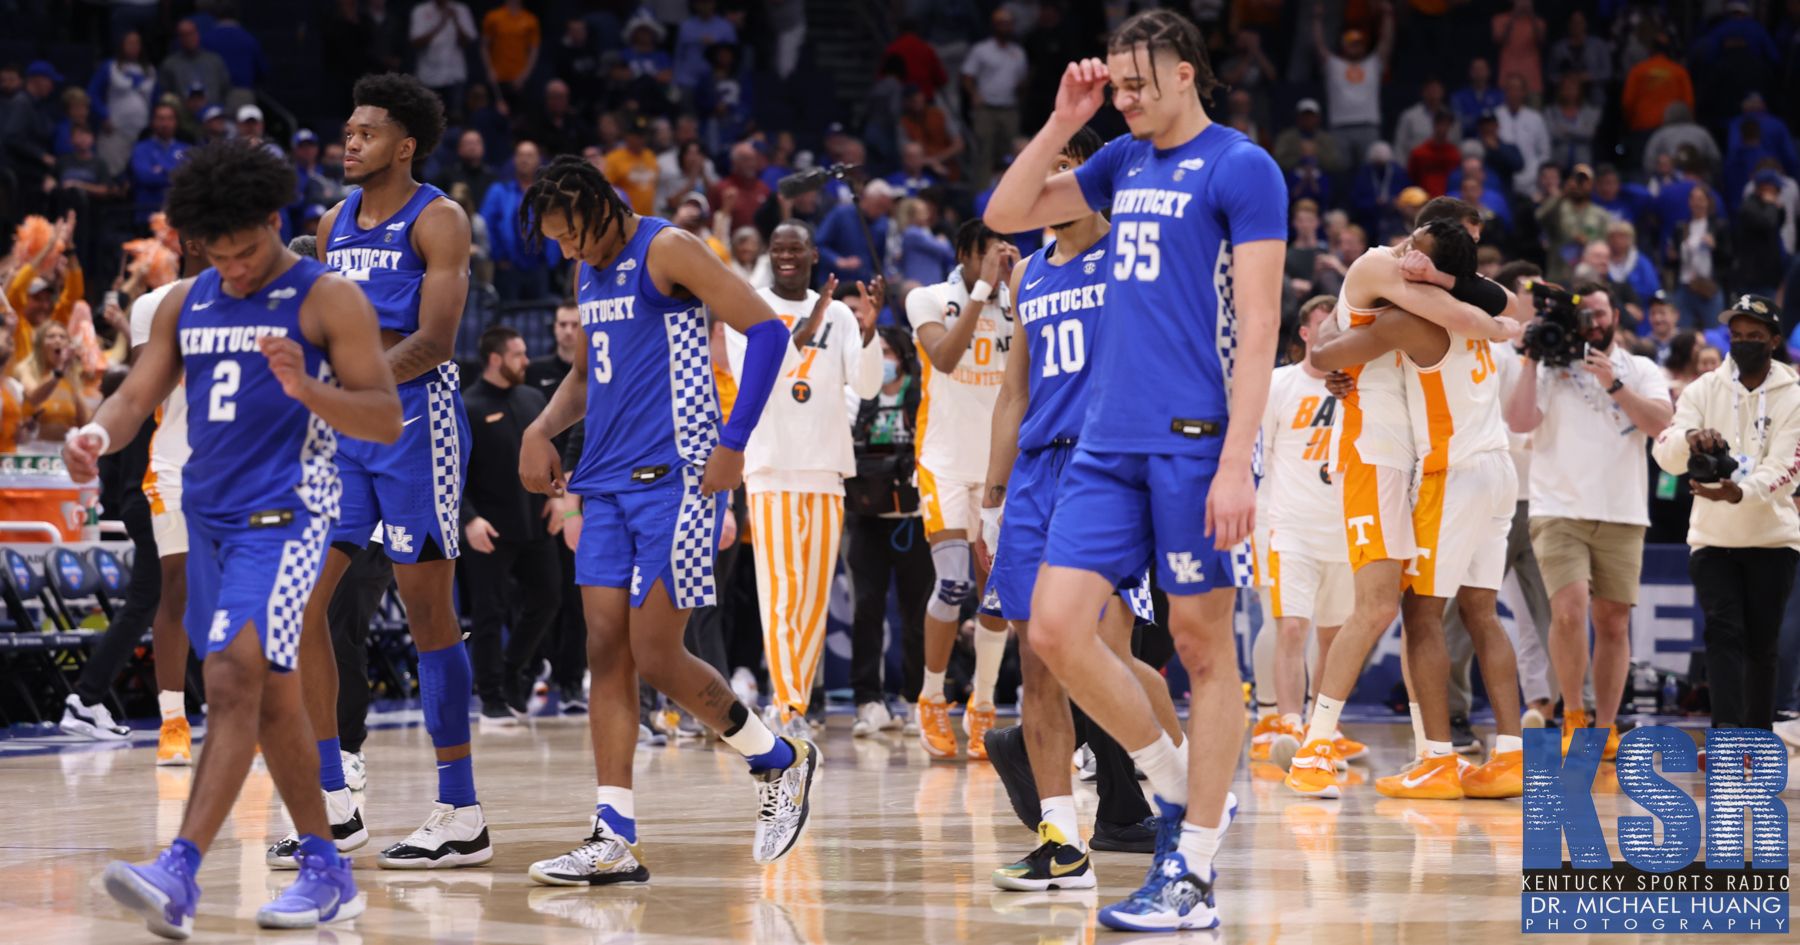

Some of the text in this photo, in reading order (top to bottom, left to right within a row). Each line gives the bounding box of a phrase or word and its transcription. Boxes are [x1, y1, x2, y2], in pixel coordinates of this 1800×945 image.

[1111, 188, 1193, 218] KENTUCKY
[326, 248, 403, 272] KENTUCKY
[1113, 221, 1161, 282] 55
[578, 295, 635, 326] NTUCKY
[1019, 283, 1107, 326] KENTUCKY
[591, 331, 612, 384] 3
[975, 337, 992, 366] 0
[1040, 318, 1086, 378] 10
[208, 360, 241, 421] 2
[385, 523, 413, 553] UK
[1348, 515, 1375, 545] T
[1166, 551, 1205, 584] UK
